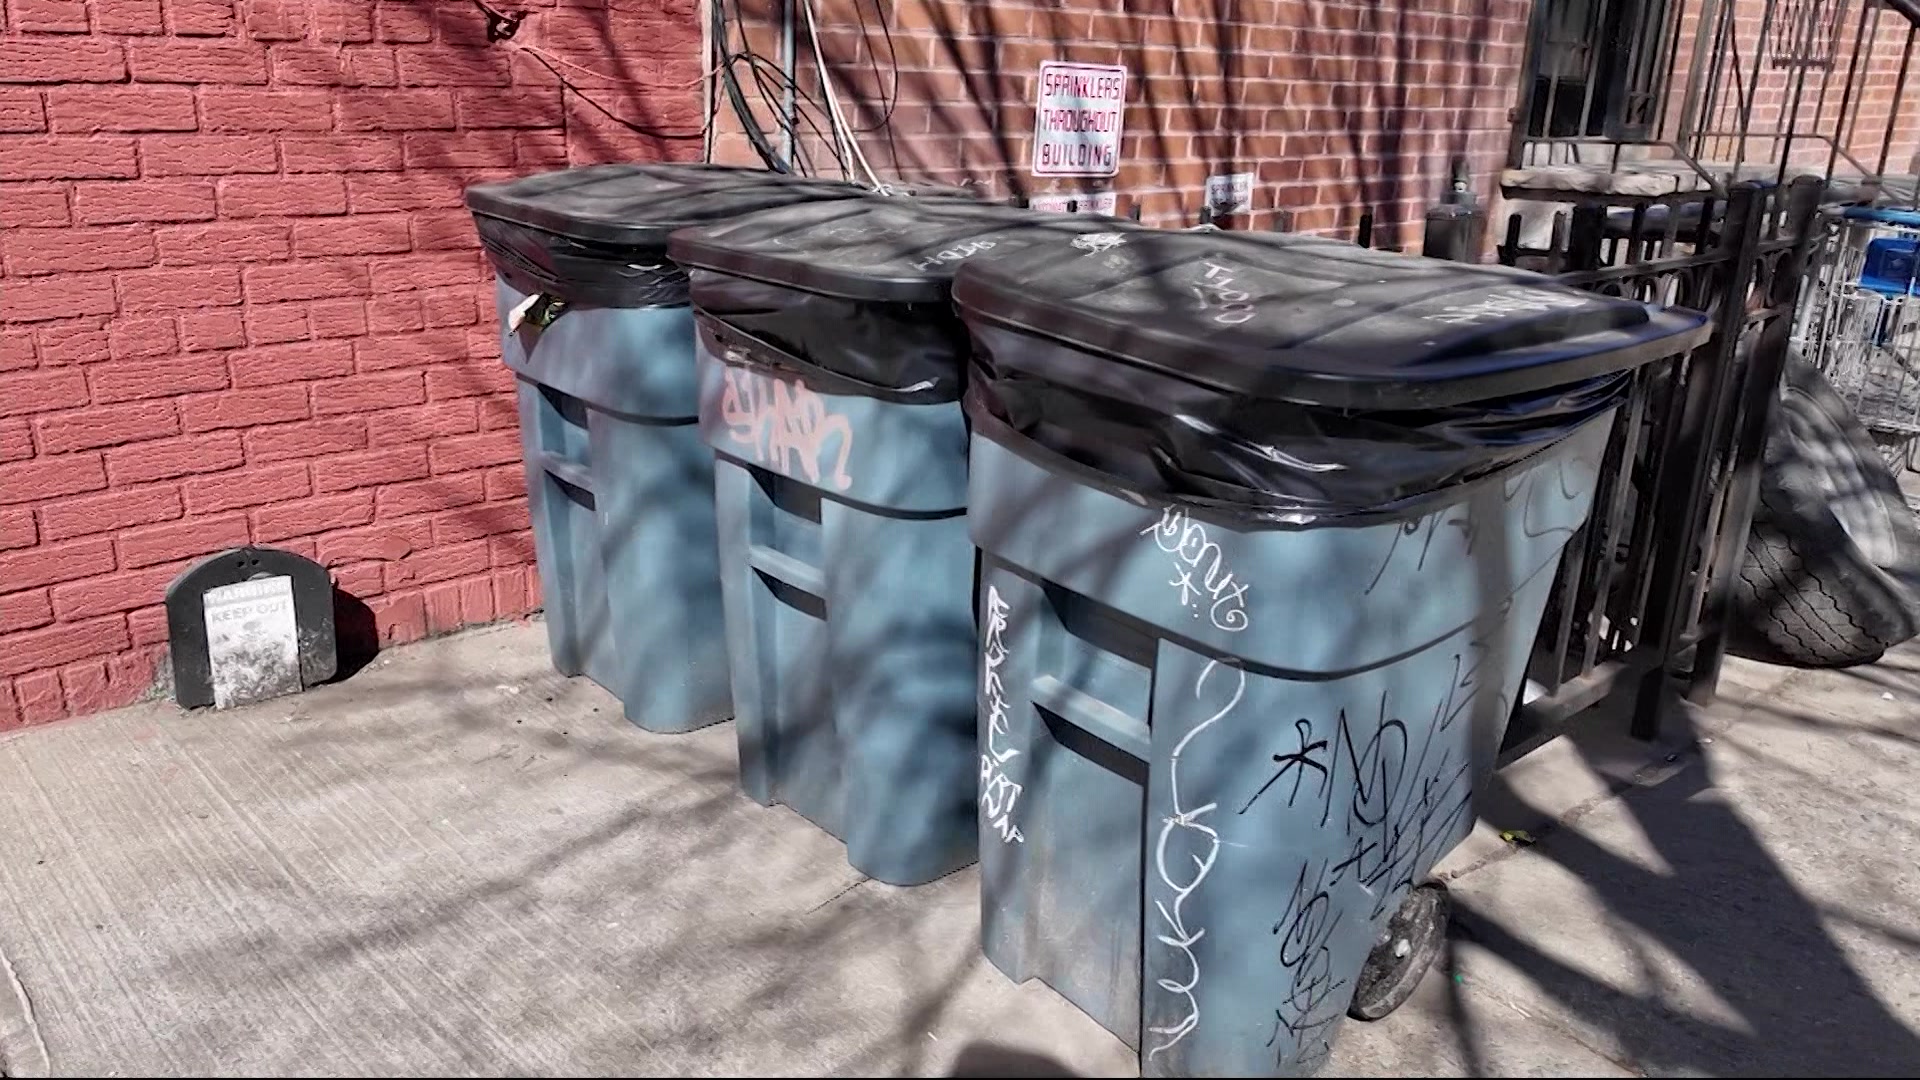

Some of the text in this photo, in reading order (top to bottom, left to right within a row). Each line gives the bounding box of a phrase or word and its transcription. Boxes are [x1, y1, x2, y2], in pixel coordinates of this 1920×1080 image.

[1044, 73, 1120, 100] SPRINKLERS
[1043, 109, 1117, 132] THROUGHOUT
[1042, 143, 1112, 166] BUILDING
[211, 599, 287, 623] KEEP OUT
